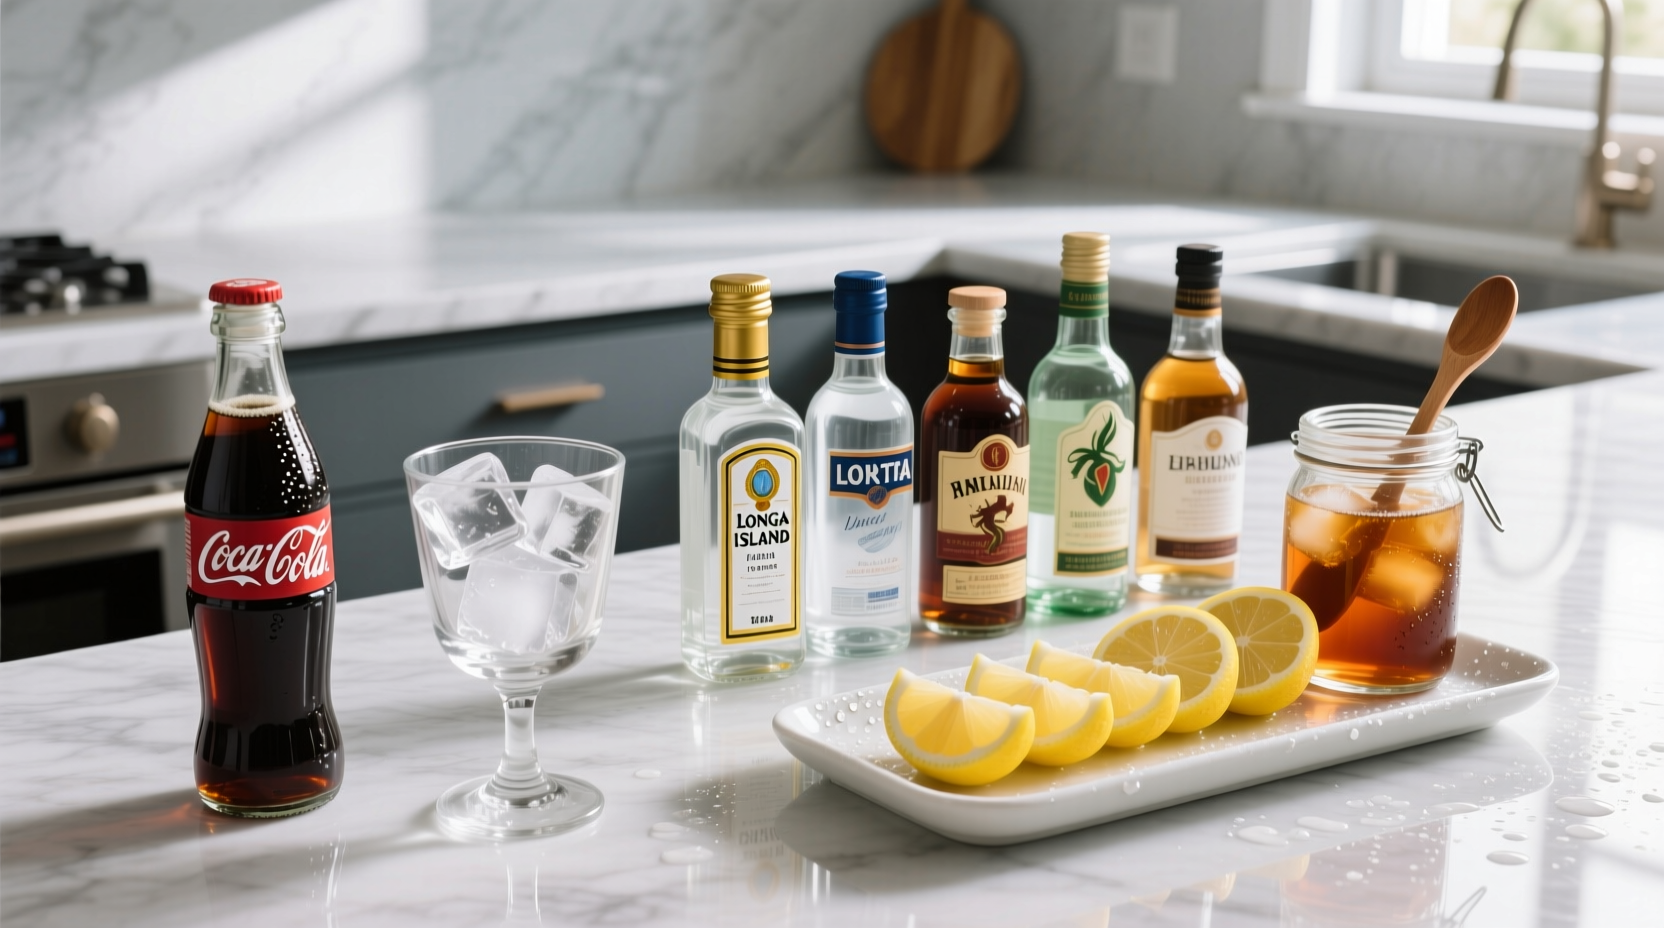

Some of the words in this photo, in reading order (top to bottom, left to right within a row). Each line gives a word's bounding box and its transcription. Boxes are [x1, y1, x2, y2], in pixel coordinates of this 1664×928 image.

[736, 511, 790, 529] LONGA
[734, 529, 790, 548] ISLAND
[198, 519, 331, 586] Coca-Cola
